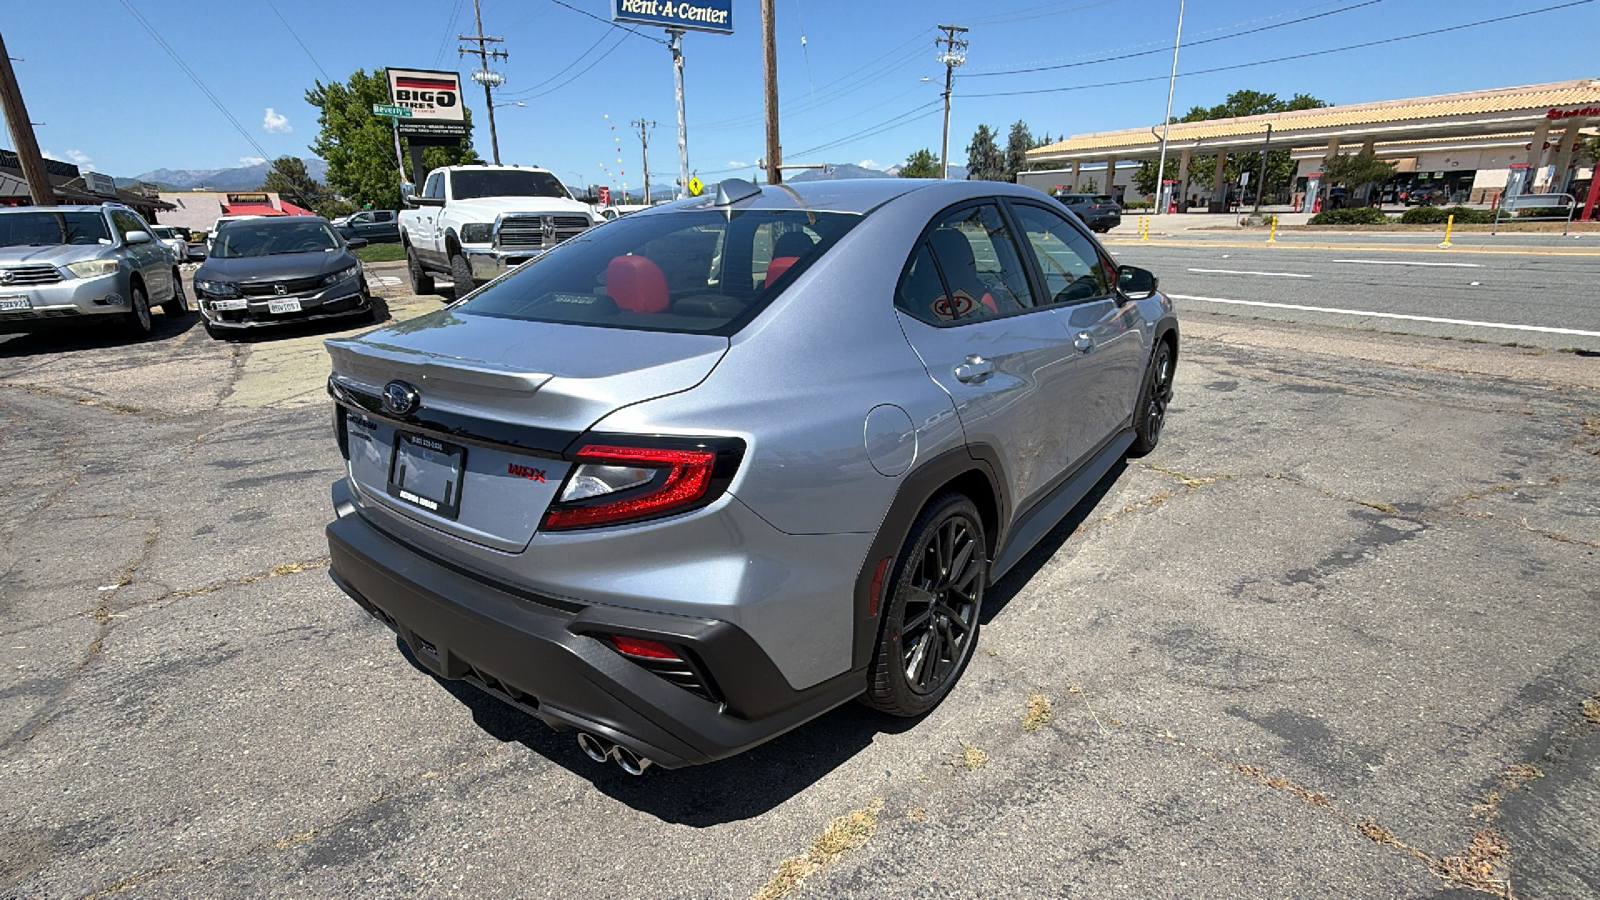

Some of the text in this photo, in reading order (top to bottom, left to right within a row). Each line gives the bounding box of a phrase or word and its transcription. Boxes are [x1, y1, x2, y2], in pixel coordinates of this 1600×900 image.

[396, 90, 434, 102] BIG
[374, 105, 403, 116] Beverly
[507, 462, 547, 483] WRX
